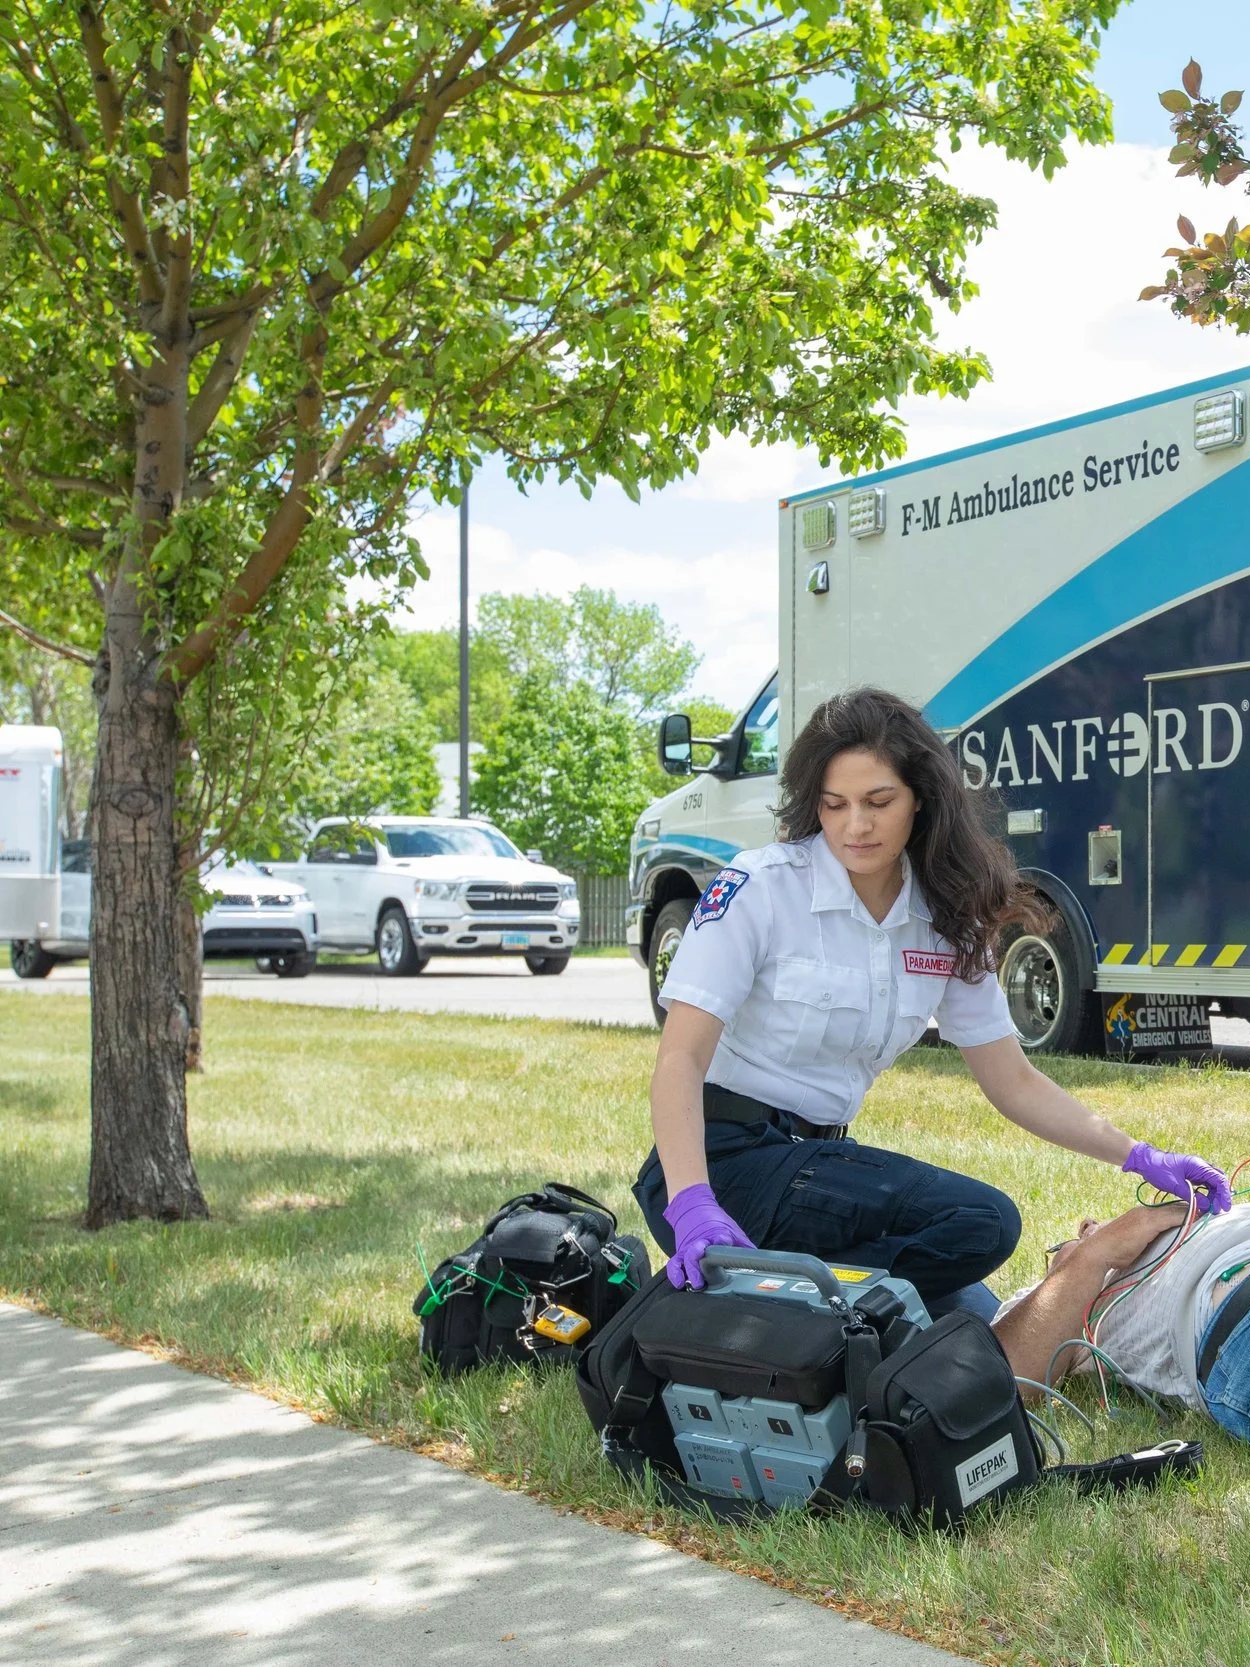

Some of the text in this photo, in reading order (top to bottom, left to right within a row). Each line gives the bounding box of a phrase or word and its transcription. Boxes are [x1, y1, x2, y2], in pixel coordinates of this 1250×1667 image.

[901, 439, 1180, 536] F-M Ambulance Service
[682, 792, 703, 811] 6750
[495, 892, 536, 901] RAM
[1136, 1005, 1210, 1029] CENTRAL
[1132, 1029, 1212, 1047] EMERGENCY VEHICLES
[695, 1406, 705, 1418] 2
[775, 1421, 785, 1433] 1
